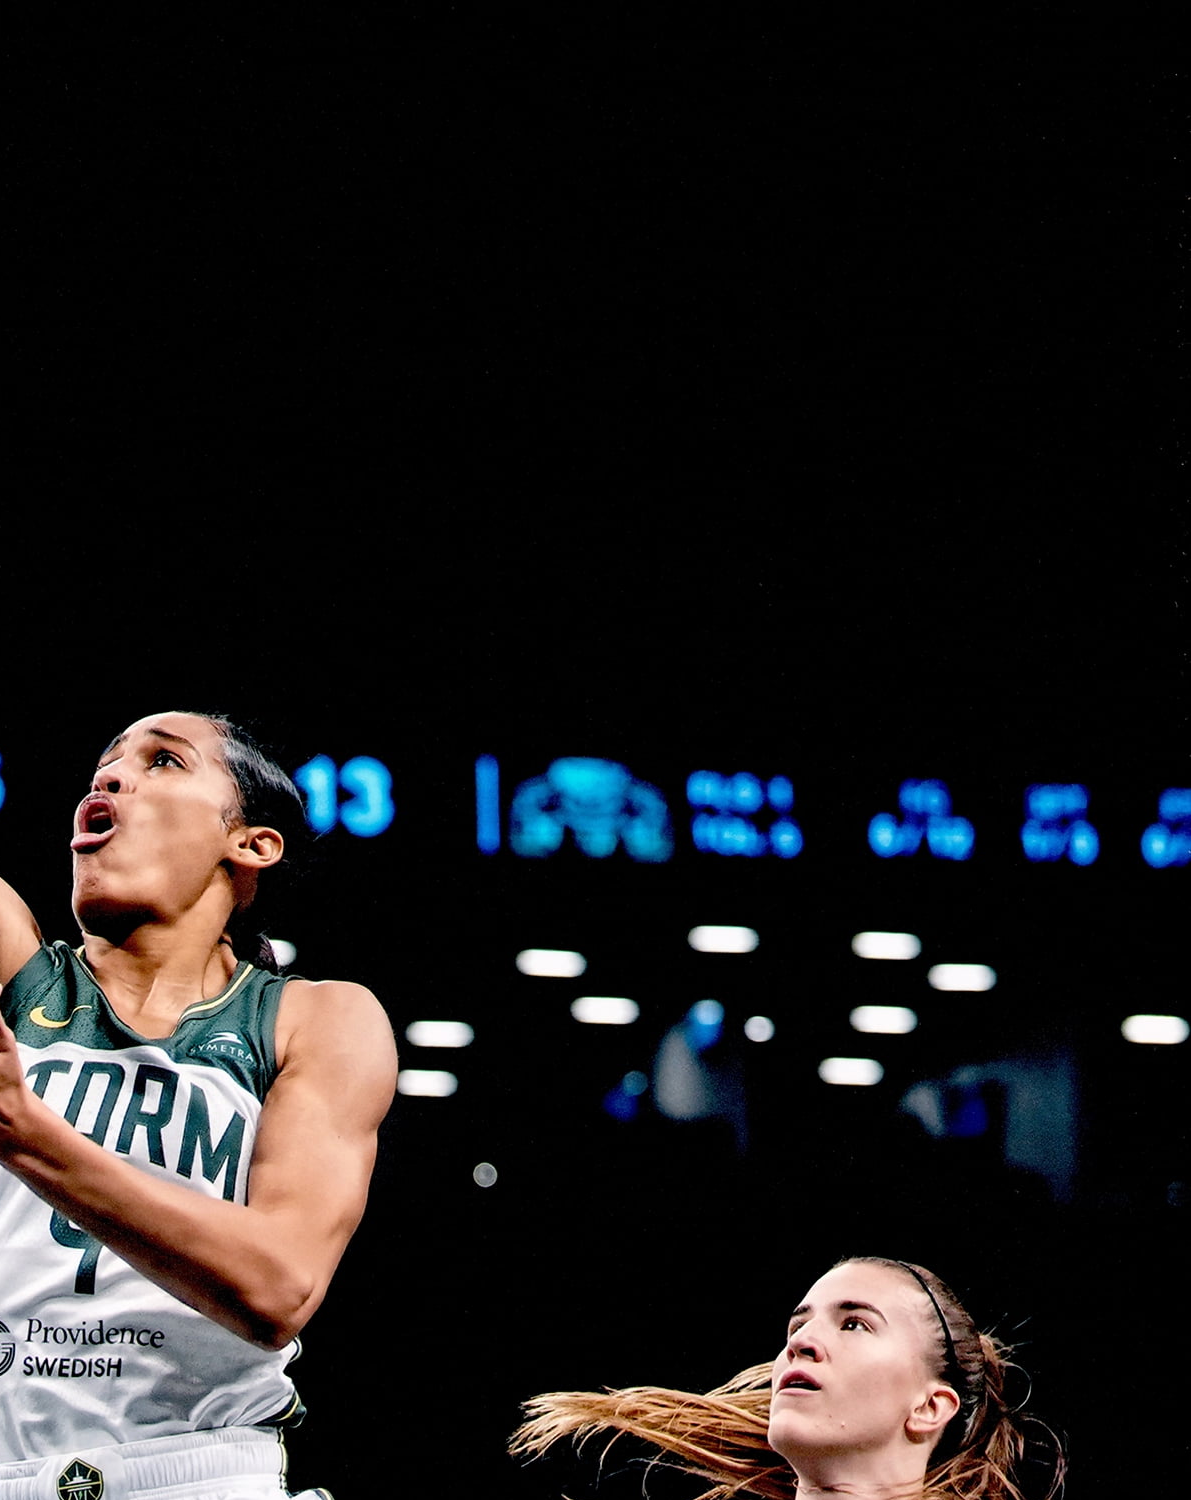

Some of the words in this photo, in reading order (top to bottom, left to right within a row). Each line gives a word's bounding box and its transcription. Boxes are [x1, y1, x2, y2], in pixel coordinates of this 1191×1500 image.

[294, 753, 395, 838] 13
[190, 1043, 255, 1063] SYMETRA
[24, 1317, 166, 1349] Providence
[22, 1356, 123, 1378] SWEDISH
